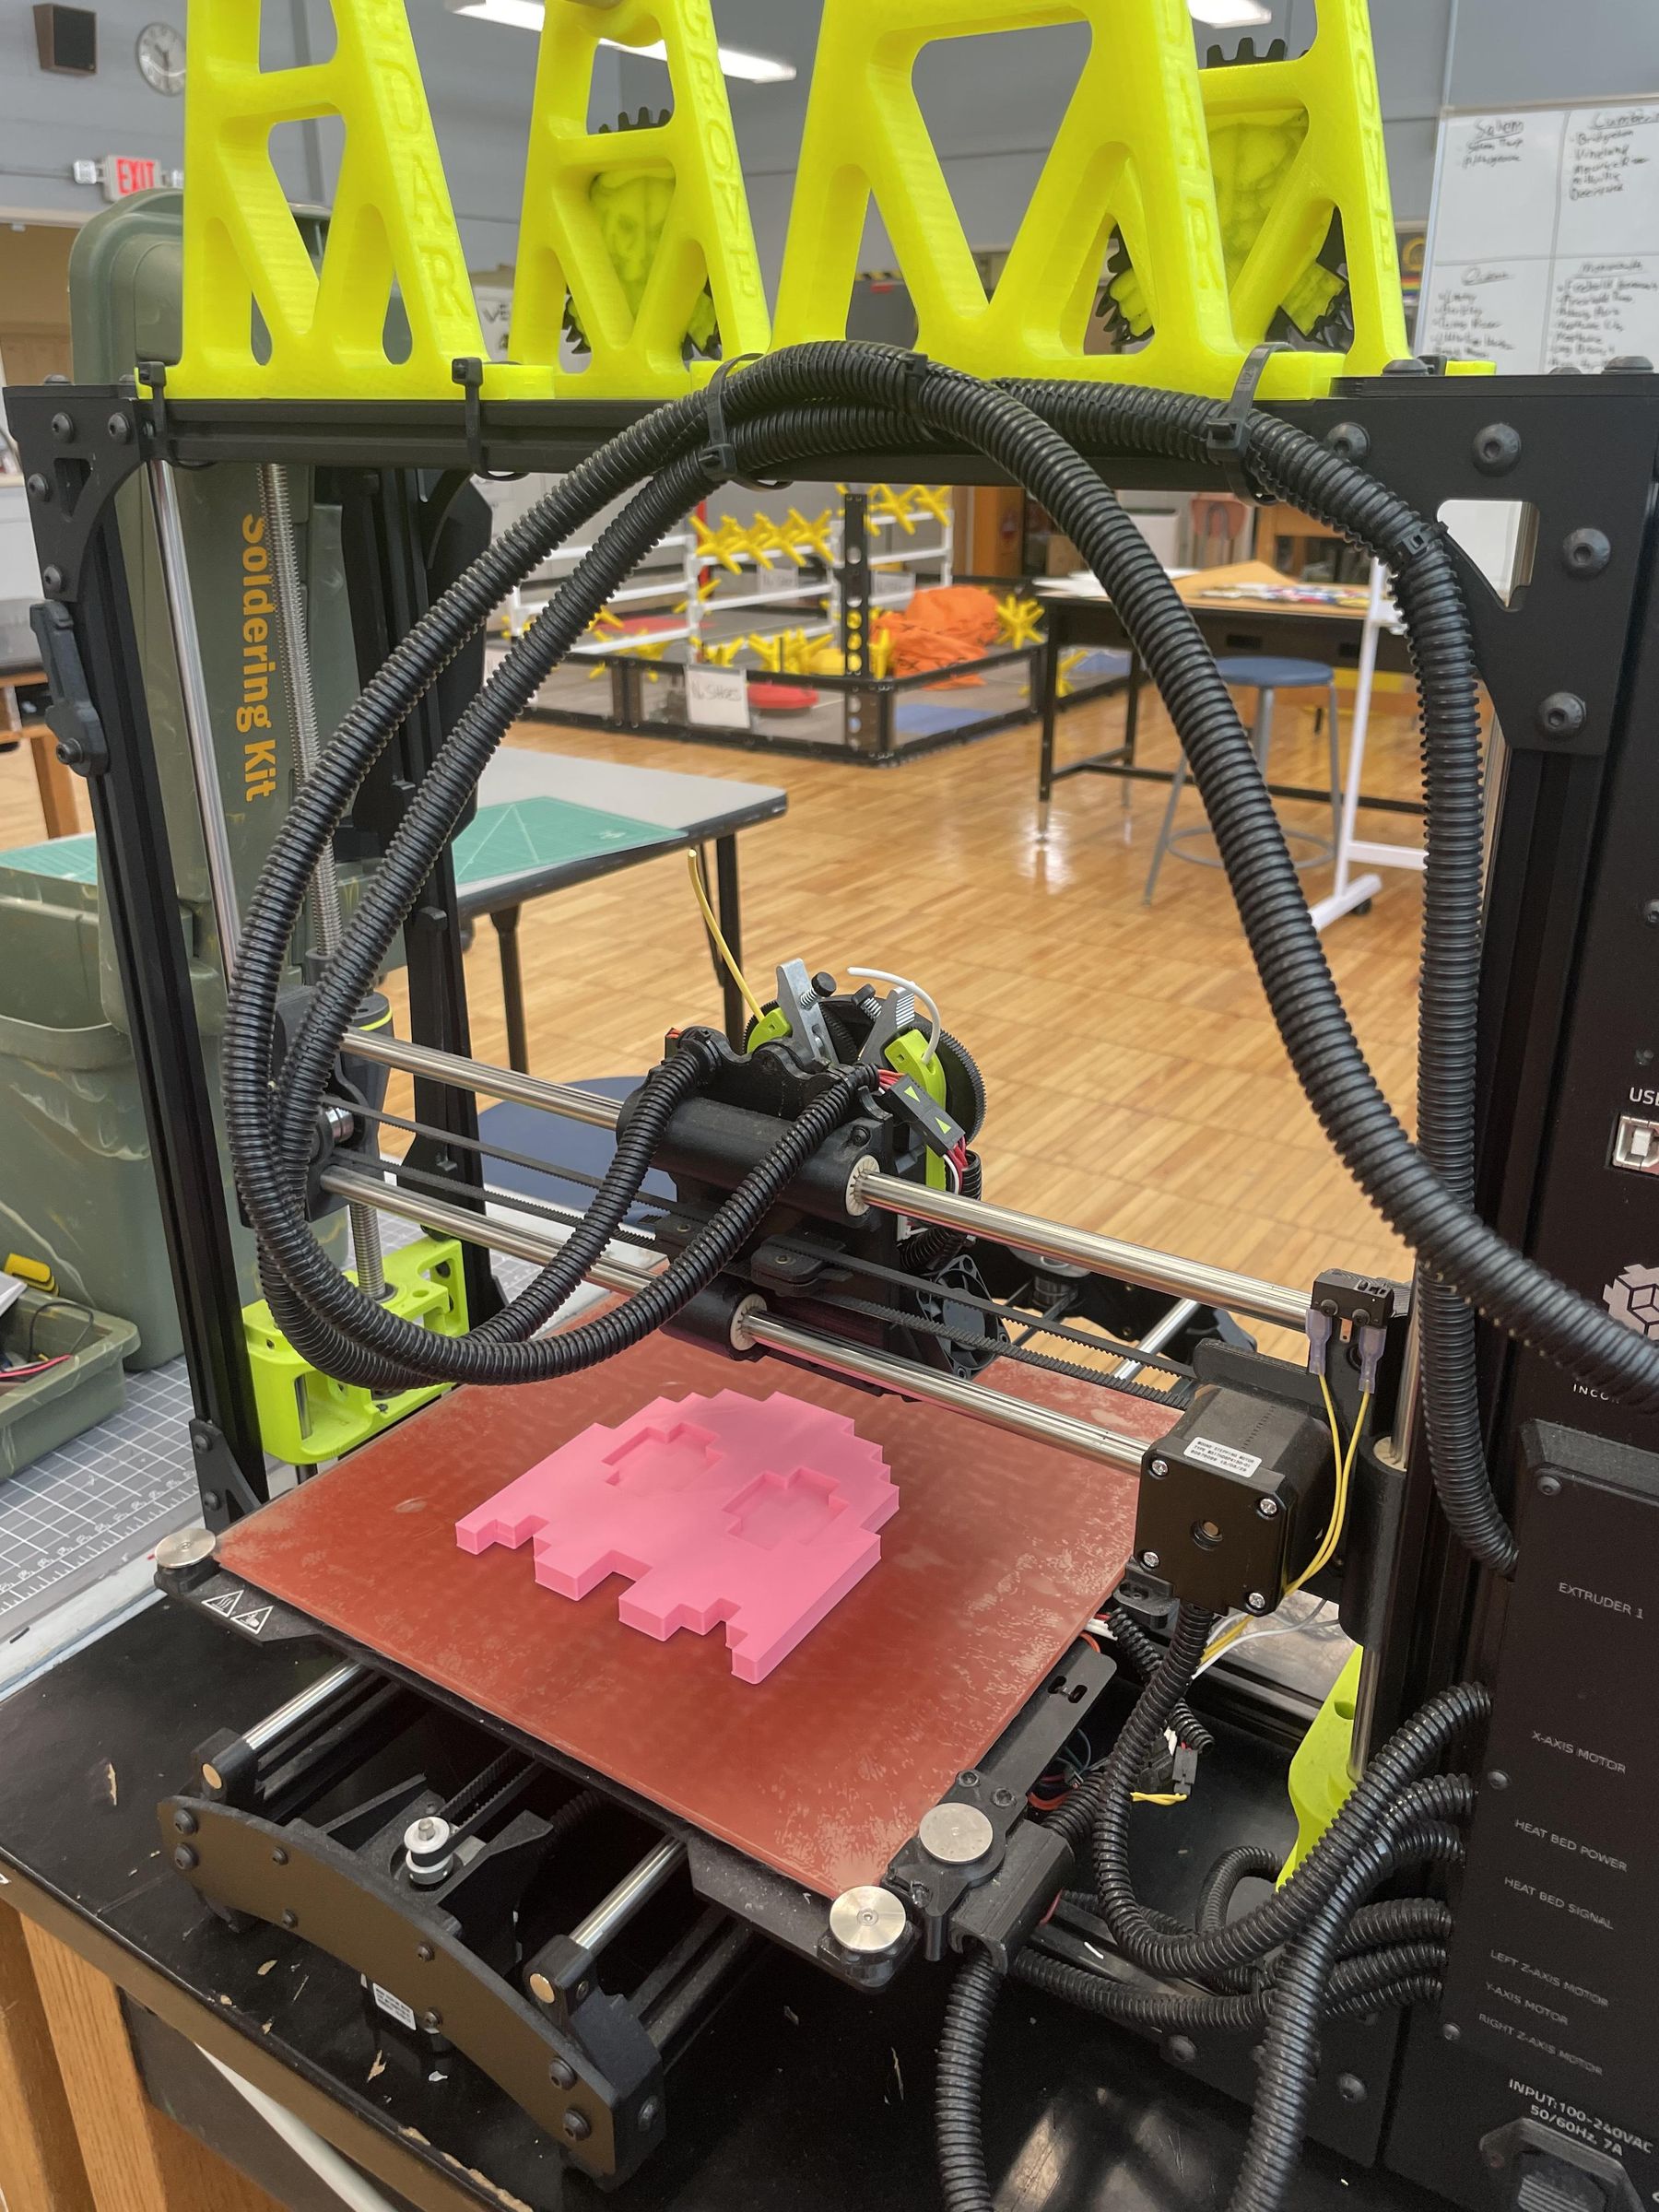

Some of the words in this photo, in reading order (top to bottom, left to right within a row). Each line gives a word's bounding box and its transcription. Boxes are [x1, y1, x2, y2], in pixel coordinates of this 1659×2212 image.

[116, 158, 155, 195] EXIT
[236, 513, 276, 734] Soldering
[244, 739, 276, 803] Kit
[1559, 1582, 1631, 1615] EXTRUDER
[1636, 1608, 1643, 1619] 1
[1532, 1730, 1573, 1754] X-AXIS
[1578, 1747, 1626, 1774] MOTOR
[1515, 1818, 1547, 1840] HEAT
[1550, 1833, 1577, 1851] BED
[1581, 1846, 1628, 1873] POWER
[1504, 1877, 1535, 1896] HEAT
[1539, 1891, 1565, 1909] BED
[1569, 1903, 1614, 1930] SIGNAL
[1486, 1981, 1521, 2005] Y-AXIS
[1524, 1998, 1569, 2026] MOTOR
[1490, 1949, 1518, 1968] LEFT
[1521, 1962, 1560, 1988] Z-AXIS
[1564, 1981, 1609, 2008] MOTOR
[1478, 2013, 1514, 2037] RIGHT
[1517, 2030, 1556, 2056] Z-AXIS
[1559, 2049, 1603, 2077] MOTOR
[1604, 2137, 1623, 2157] 7A
